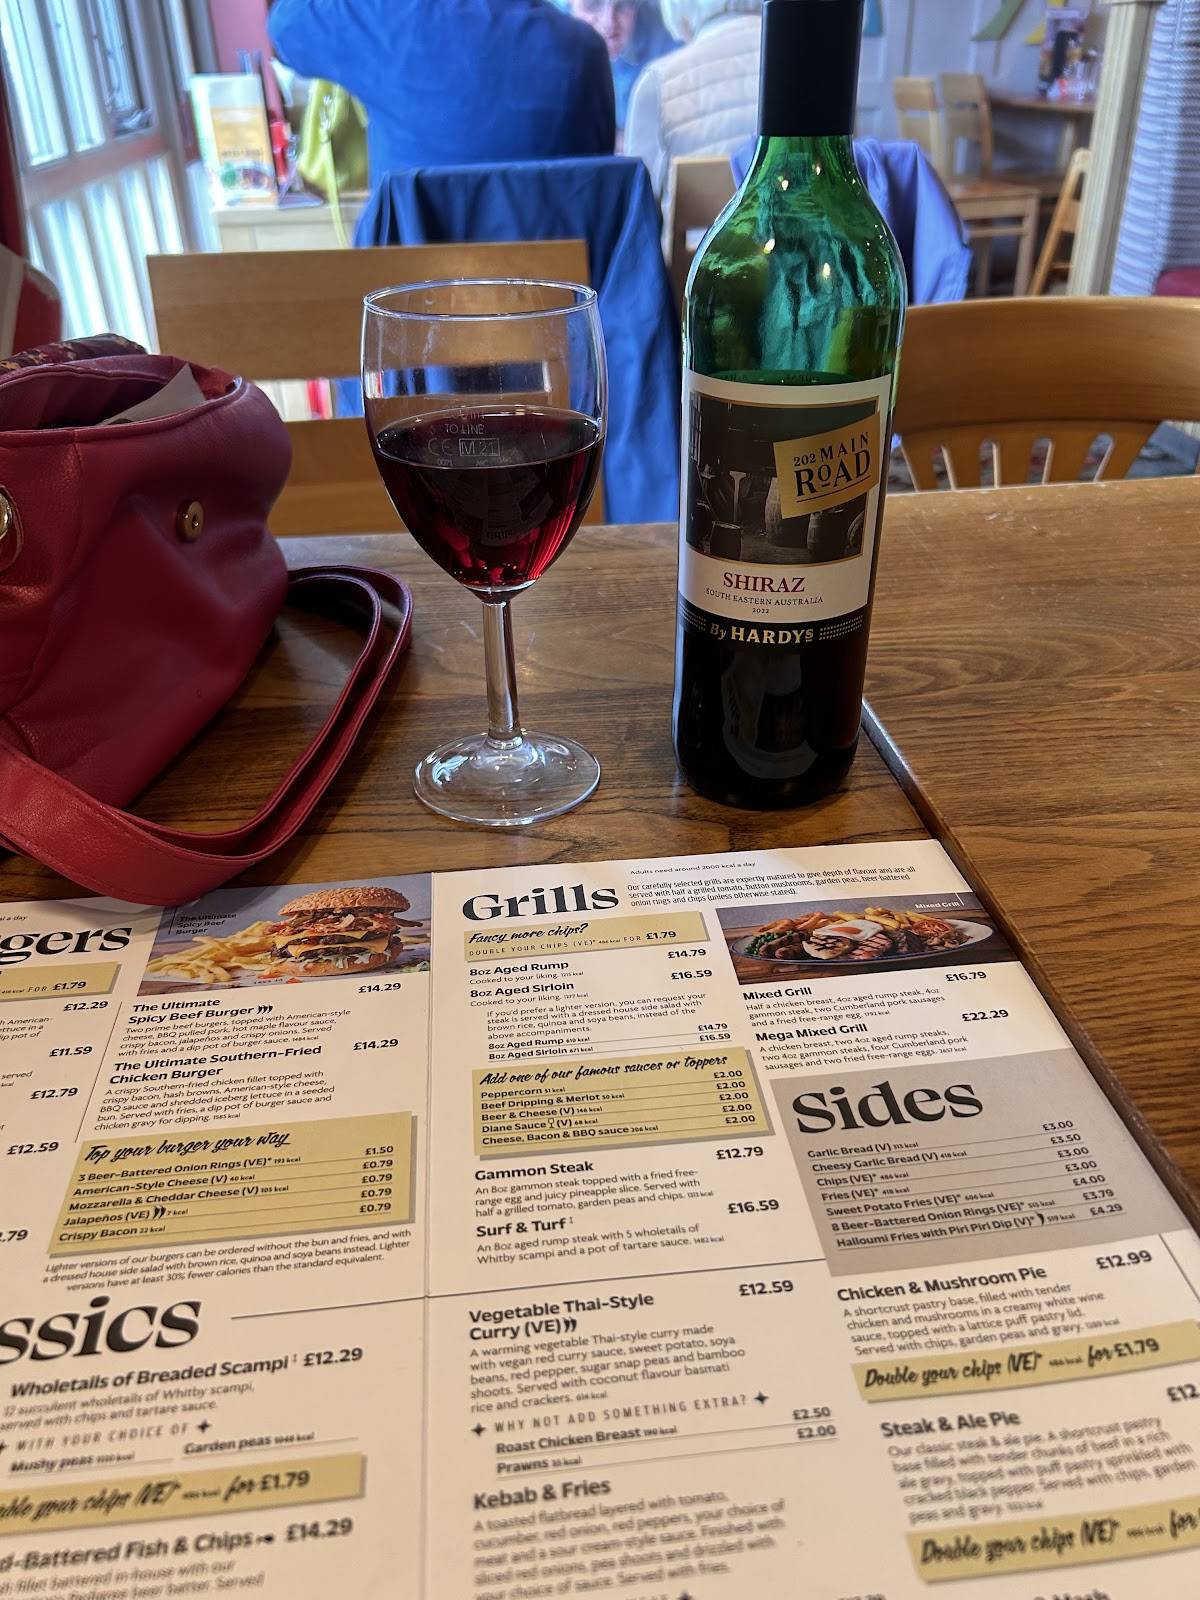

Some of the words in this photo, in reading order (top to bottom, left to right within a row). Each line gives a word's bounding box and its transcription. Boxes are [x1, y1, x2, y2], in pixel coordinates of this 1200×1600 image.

[461, 424, 485, 435] LINE
[794, 454, 816, 467] 202
[820, 432, 869, 460] MAIN
[795, 450, 870, 496] ROAD
[706, 588, 731, 601] SOUTH
[733, 595, 772, 605] EASTERN
[774, 597, 823, 606] AUSTRALIA
[723, 572, 805, 593] SHIRAZ
[710, 622, 727, 640] By
[462, 883, 619, 921] Grills
[0, 928, 133, 965] gers
[468, 932, 509, 943] Fancy
[510, 930, 545, 939] more
[547, 922, 588, 937] chips?
[469, 947, 506, 956] DOUBLE
[646, 930, 676, 939] £1.79
[494, 964, 527, 974] Aged
[531, 962, 568, 970] Rump
[668, 948, 706, 958] £14.79
[52, 981, 86, 990] £1.79
[469, 976, 502, 984] Cooked
[470, 989, 492, 997] 8oz
[495, 985, 529, 996] Aged
[533, 982, 574, 992] Sirloin
[671, 969, 712, 979] £16.59
[743, 989, 782, 1000] Mixed
[784, 987, 812, 996] Grill
[945, 971, 986, 981] £16.79
[63, 1001, 108, 1011] £12.29
[133, 1004, 158, 1012] The
[161, 999, 220, 1010] Ultimate
[358, 982, 401, 993] £14.29
[128, 1015, 166, 1024] Spicy
[169, 1010, 203, 1020] Beef
[205, 1007, 254, 1017] Burger
[144, 1025, 171, 1033] prime
[231, 1016, 263, 1025] topped
[286, 1010, 350, 1020] American-style
[755, 1032, 793, 1041] Mega
[795, 1026, 836, 1037] Mixed
[839, 1023, 867, 1033] Grill
[962, 1009, 1008, 1021] £22.29
[49, 1046, 93, 1058] £11.59
[114, 1062, 141, 1071] The
[144, 1057, 206, 1068] Ultimate
[210, 1046, 321, 1063] Southern-Fried
[353, 1038, 398, 1050] £14.29
[110, 1073, 167, 1084] Chicken
[171, 1068, 223, 1079] Burger
[479, 1072, 507, 1085] Add
[509, 1074, 533, 1083] one
[534, 1068, 549, 1082] of
[551, 1070, 573, 1079] our
[575, 1065, 620, 1079] famous
[624, 1062, 663, 1072] sauces
[666, 1061, 680, 1069] or
[684, 1056, 727, 1069] toppers
[481, 1088, 542, 1098] Peppercorn
[713, 1070, 742, 1079] £2.00
[30, 1087, 79, 1100] £12.79
[792, 1081, 983, 1134] Sides
[7, 1141, 58, 1155] £12.59
[84, 1145, 111, 1164] Top
[110, 1145, 155, 1162] your
[156, 1140, 212, 1156] burger
[211, 1136, 255, 1153] your
[256, 1132, 290, 1148] way
[807, 1149, 839, 1158] Garlic
[840, 1145, 873, 1154] Bread
[874, 1143, 891, 1152] (V)
[1042, 1120, 1073, 1131] £3.00
[78, 1174, 86, 1182] 3
[88, 1166, 172, 1180] Beer-Battered
[174, 1164, 207, 1172] Onion
[210, 1161, 241, 1169] Rings
[365, 1145, 394, 1155] £1.50
[475, 1167, 546, 1180] Gammon
[550, 1161, 593, 1174] Steak
[716, 1146, 763, 1159] £12.79
[63, 1214, 122, 1226] Jalapeños
[125, 1210, 150, 1221] (VE)
[361, 1187, 392, 1198] £0.79
[826, 1206, 862, 1216] Sweet
[863, 1202, 902, 1212] Potato
[903, 1199, 932, 1208] Fries
[1072, 1174, 1105, 1186] £4.00
[59, 1232, 98, 1241] Crispy
[100, 1228, 137, 1237] Bacon
[359, 1202, 391, 1213] £0.79
[476, 1223, 512, 1237] Surf
[516, 1222, 527, 1233] &
[531, 1218, 566, 1231] Turf
[728, 1199, 779, 1214] £16.59
[837, 1286, 905, 1301] Chicken
[908, 1281, 922, 1294] &
[924, 1272, 1016, 1291] Mushroom
[1018, 1267, 1046, 1280] Pie
[1096, 1250, 1152, 1269] £12.99
[469, 1303, 559, 1323] Vegetable
[563, 1295, 653, 1312] Thai-Style
[739, 1280, 793, 1296] £12.59
[469, 1326, 520, 1340] Curry
[524, 1319, 561, 1337] (VE)
[12, 1376, 107, 1397] Wholetails
[112, 1371, 134, 1387] of
[137, 1364, 216, 1384] Breaded
[220, 1356, 288, 1375] Scampi
[304, 1348, 362, 1366] £12.29
[881, 1419, 935, 1436] Steak
[938, 1417, 953, 1431] &
[957, 1414, 987, 1429] Ale
[989, 1412, 1020, 1426] Pie
[474, 1488, 537, 1509] Kebab
[542, 1484, 557, 1501] &
[562, 1480, 610, 1498] Fries
